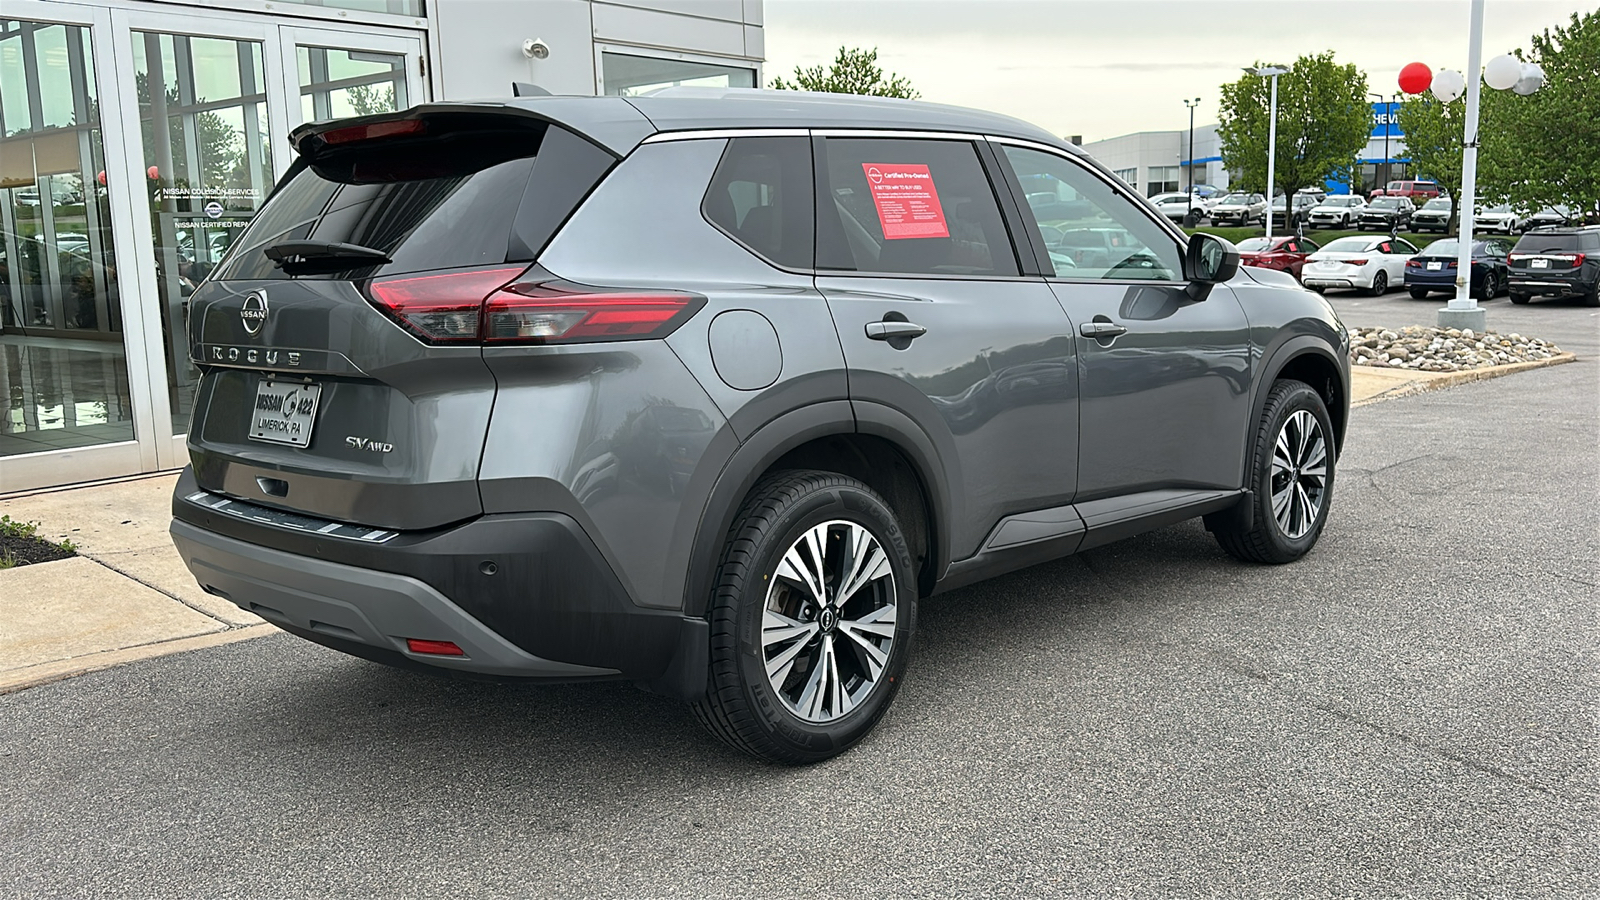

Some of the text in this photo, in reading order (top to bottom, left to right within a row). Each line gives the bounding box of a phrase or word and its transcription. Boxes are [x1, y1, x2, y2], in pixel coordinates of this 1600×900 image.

[163, 187, 260, 196] NISSAN COLLISION SERVICES
[174, 221, 200, 229] NISSAN
[240, 310, 266, 319] NISSAN
[212, 346, 302, 366] ROGUE
[256, 393, 315, 416] NISSAN 422
[257, 418, 301, 434] LIMERICK, PA
[345, 436, 394, 453] SV AWD
